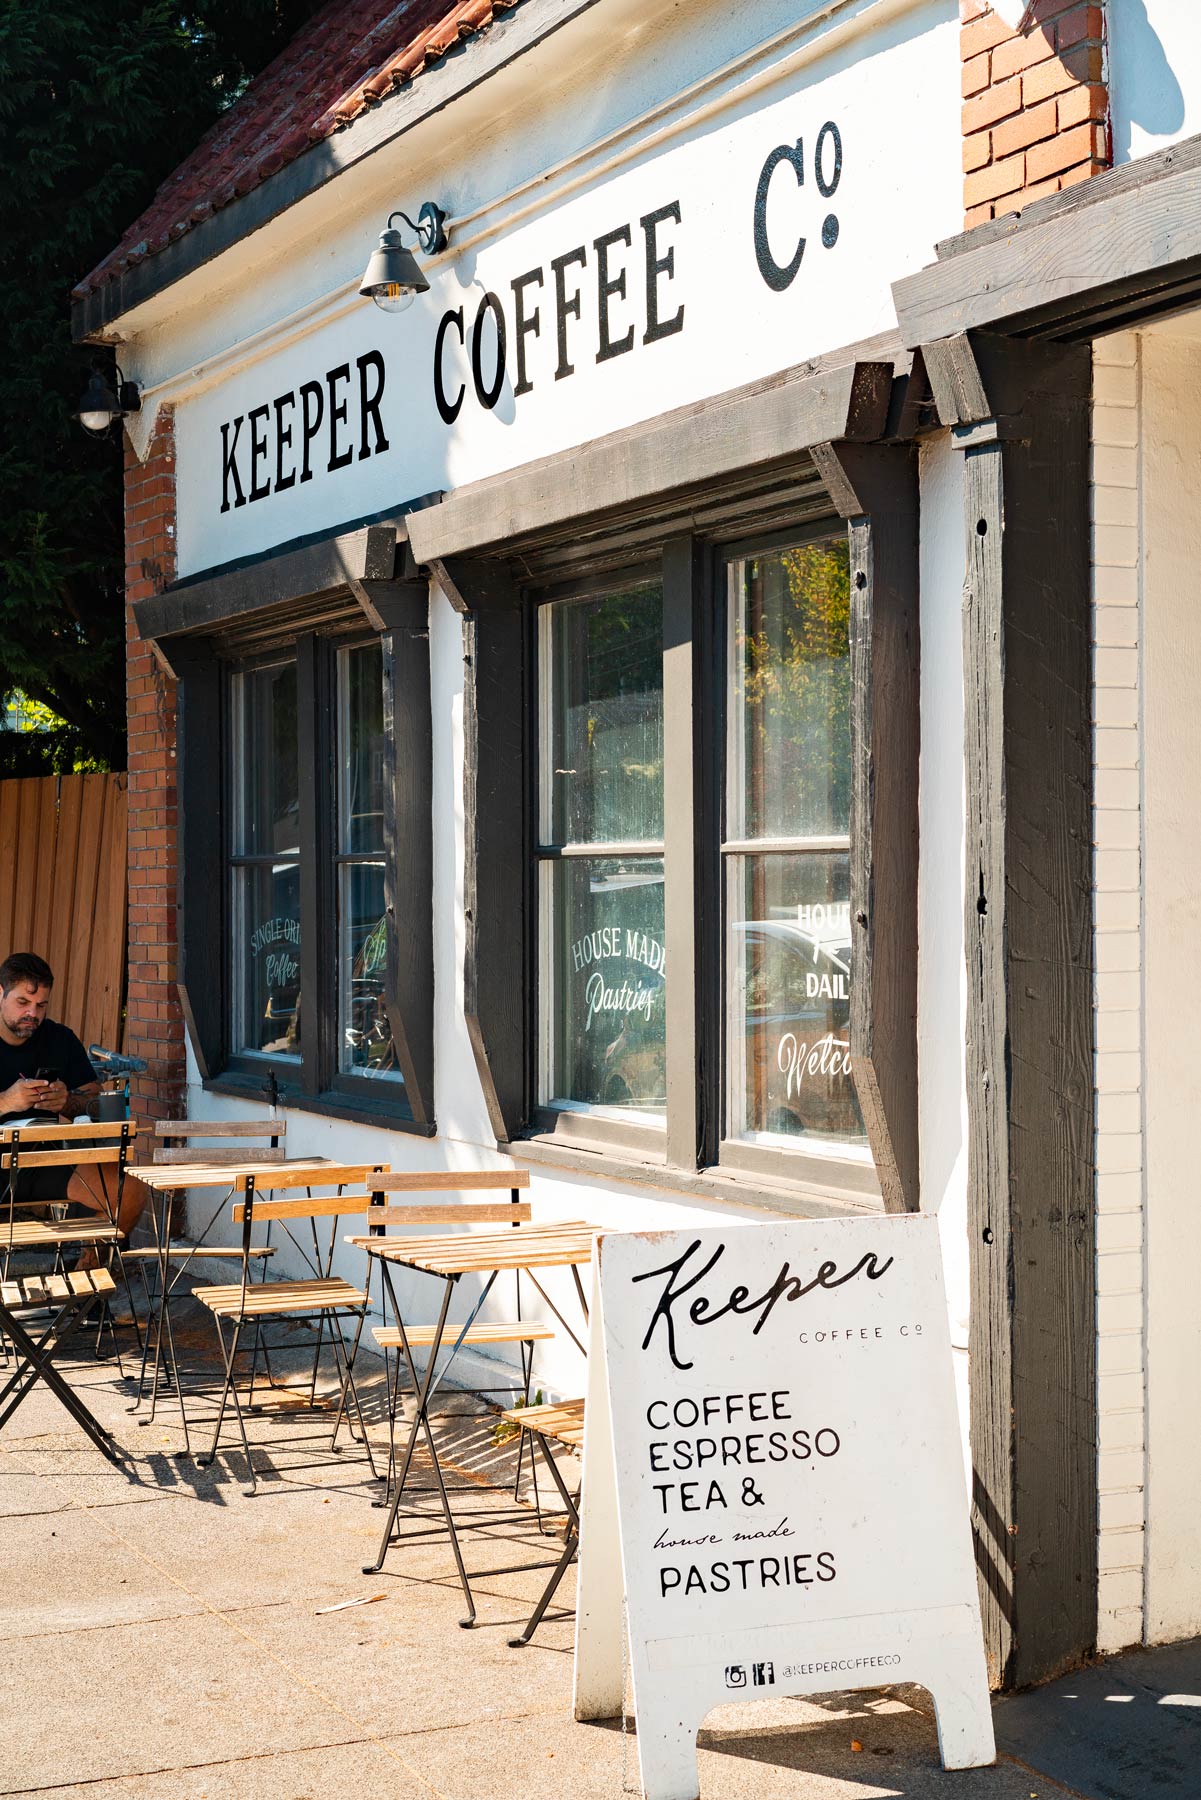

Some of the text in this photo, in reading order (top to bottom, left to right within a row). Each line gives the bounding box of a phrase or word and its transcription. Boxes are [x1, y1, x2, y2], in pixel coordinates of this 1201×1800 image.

[220, 349, 390, 513] KEEPER
[433, 200, 685, 425] COFFEE
[250, 917, 301, 957] SINGLE ORI
[571, 927, 622, 973] HOUSE
[265, 952, 299, 987] Coffee
[806, 972, 851, 1000] DAIL
[585, 972, 655, 1032] Pastries
[631, 1239, 894, 1371] Keeper
[799, 1325, 883, 1344] COFFEE
[646, 1390, 792, 1431] COFFEE
[649, 1427, 841, 1473] ESPRESSO
[652, 1476, 766, 1515] TEA &
[653, 1516, 796, 1549] house made
[660, 1551, 836, 1598] PASTRIES
[782, 1653, 902, 1678] @KEEPERCOFFEECO
